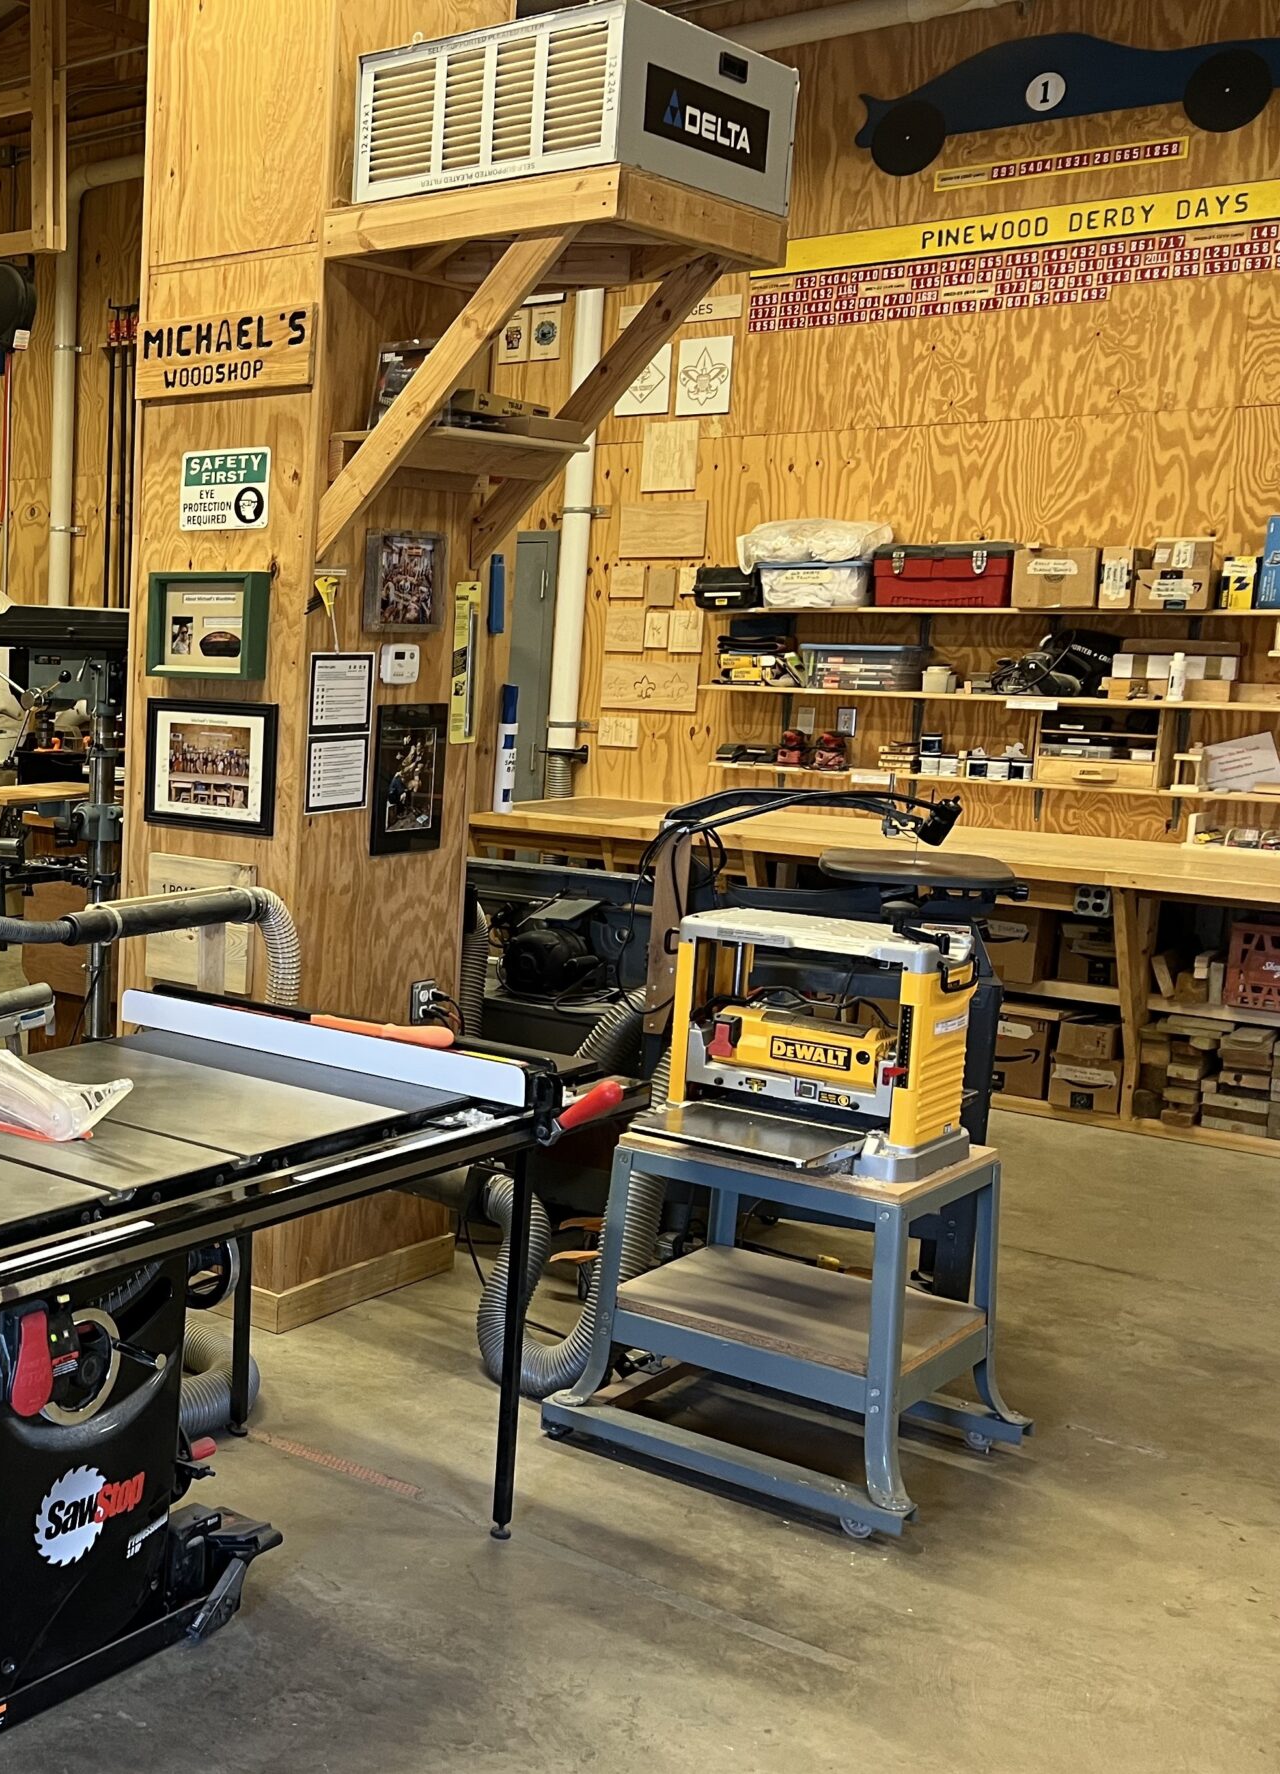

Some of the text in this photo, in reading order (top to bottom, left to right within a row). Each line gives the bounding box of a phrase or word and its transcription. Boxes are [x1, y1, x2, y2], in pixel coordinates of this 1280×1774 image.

[1039, 81, 1051, 104] 1
[685, 105, 751, 154] DELTA
[992, 165, 1015, 178] 893
[1020, 161, 1051, 174] 5404
[1057, 156, 1088, 169] 1831
[1094, 153, 1109, 164] 28
[1115, 148, 1139, 161] 665
[1145, 143, 1178, 157] 1858
[921, 192, 1249, 249] PINEWOOD DERBY DAYS
[751, 293, 777, 306] 1858
[781, 291, 808, 303] 1601
[812, 288, 832, 299] 492
[912, 277, 940, 289] 1185
[944, 273, 973, 286] 1540
[978, 271, 992, 282] 28
[996, 269, 1011, 280] 30
[1016, 266, 1038, 278] 919
[1043, 262, 1075, 276] 1785
[1080, 259, 1103, 271] 910
[1108, 255, 1140, 269] 1343
[1174, 249, 1199, 262] 858
[1205, 246, 1229, 259] 129
[1234, 242, 1269, 256] 1858
[796, 277, 816, 289] 152
[820, 273, 847, 286] 5404
[851, 269, 879, 282] 2010
[883, 267, 904, 279] 858
[908, 264, 936, 277] 1831
[941, 261, 956, 272] 28
[960, 259, 975, 270] 42
[979, 256, 1002, 269] 665
[1007, 252, 1038, 266] 1858
[1043, 249, 1066, 262] 149
[1071, 245, 1095, 257] 492
[1101, 242, 1125, 255] 965
[1130, 239, 1154, 252] 861
[1160, 236, 1185, 249] 717
[1252, 226, 1278, 239] 149
[750, 307, 776, 319] 1373
[780, 304, 800, 316] 152
[803, 301, 830, 314] 1484
[834, 299, 855, 310] 492
[859, 296, 879, 308] 801
[884, 293, 912, 305] 4700
[996, 281, 1026, 294] 1373
[1049, 278, 1064, 288] 28
[1069, 275, 1092, 288] 919
[1098, 271, 1130, 284] 1343
[1136, 267, 1168, 281] 1484
[1205, 260, 1239, 273] 1530
[1245, 256, 1271, 270] 637
[749, 288, 1106, 332] 1858 1132 1185 1160 42 4700 1148 152 717 801 52 436 492
[143, 310, 307, 360] MICHAEL'S
[163, 359, 264, 389] WOODSHOP
[189, 454, 262, 475] SAFETY
[201, 470, 248, 484] FIRST
[183, 501, 232, 513] PROTECTION
[199, 489, 215, 500] EYE
[186, 514, 227, 525] REQUIRED
[45, 1471, 145, 1540] SawStop
